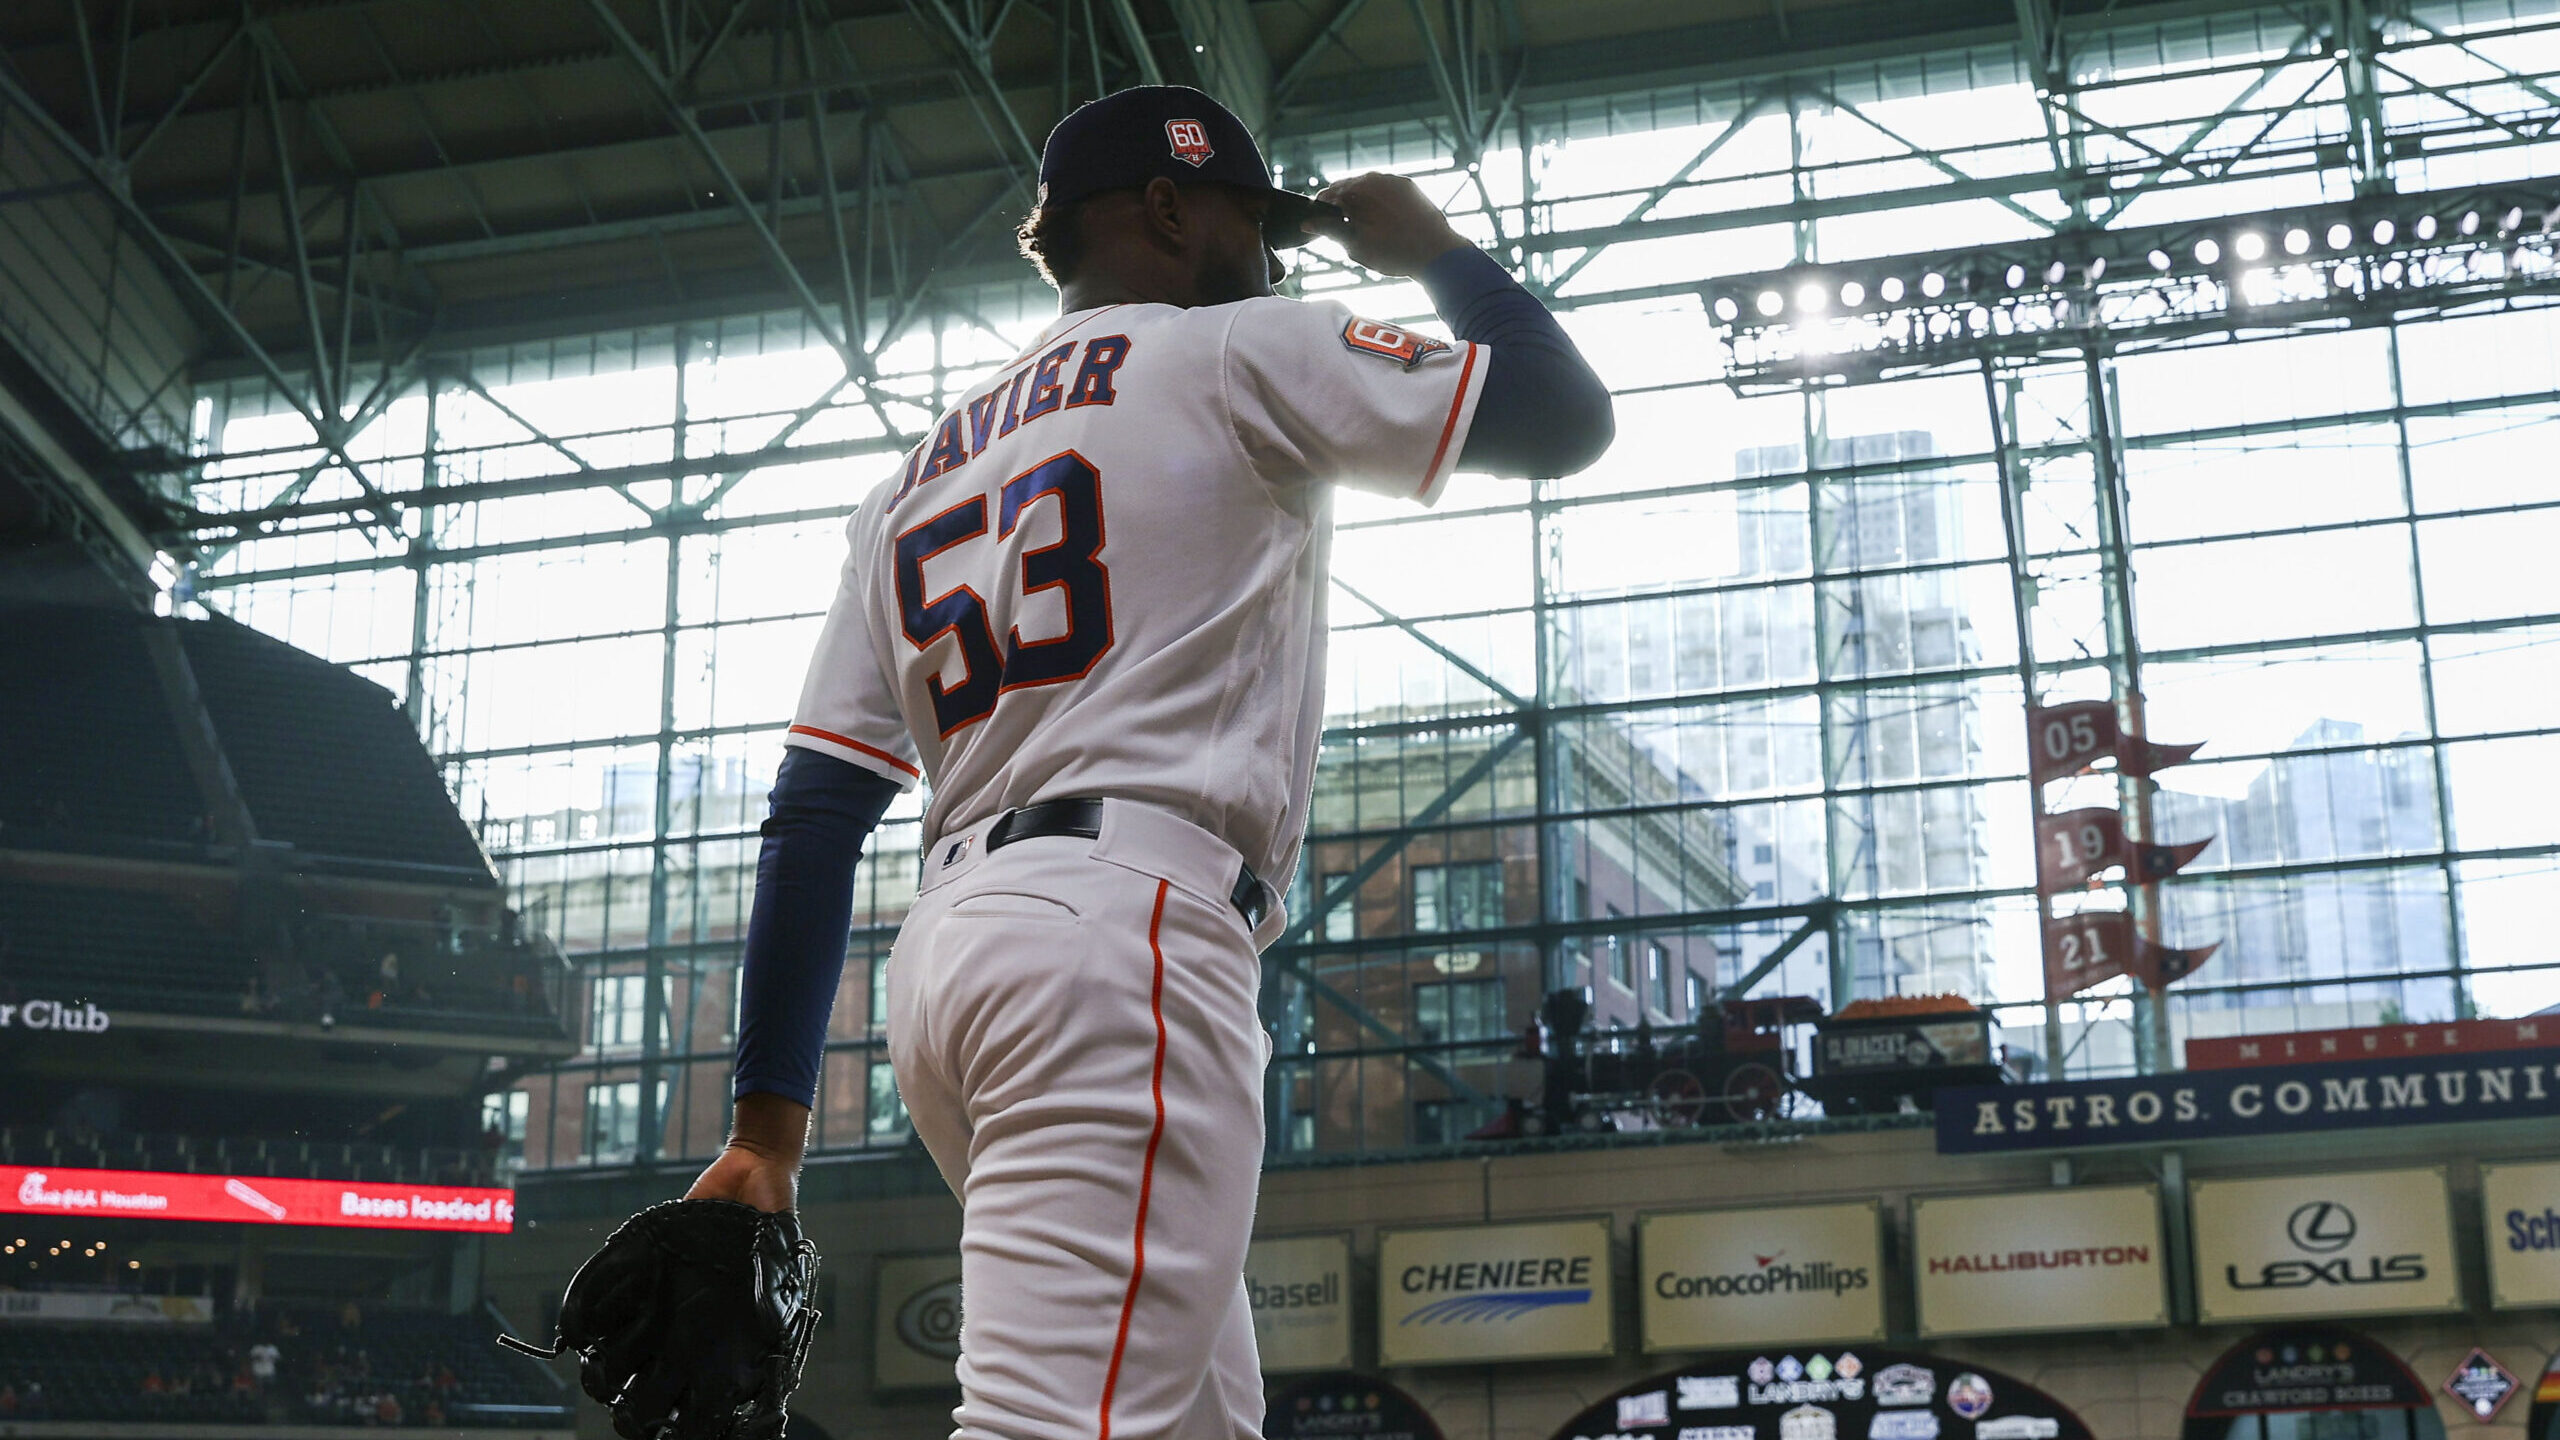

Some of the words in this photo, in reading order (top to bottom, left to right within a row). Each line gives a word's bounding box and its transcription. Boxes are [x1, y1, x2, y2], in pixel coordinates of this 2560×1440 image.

[1171, 124, 1205, 146] 60
[886, 334, 1132, 515] JAVIER
[894, 448, 1116, 742] 53
[2044, 713, 2097, 760] 05
[2054, 824, 2105, 869] 19
[2059, 928, 2108, 971] 21
[22, 1000, 110, 1033] Club
[2239, 1027, 2460, 1060] MINUTE
[1973, 1088, 2198, 1136] ASTROS
[341, 1191, 409, 1218] Bases
[411, 1194, 492, 1222] loaded
[1401, 1256, 1593, 1294] CHENIERE
[1929, 1245, 2149, 1275] HALLIBURTON
[2225, 1254, 2428, 1290] LEXUS
[1655, 1262, 1869, 1300] ConocoPhillips
[1747, 1378, 1865, 1405] LANDRY'S
